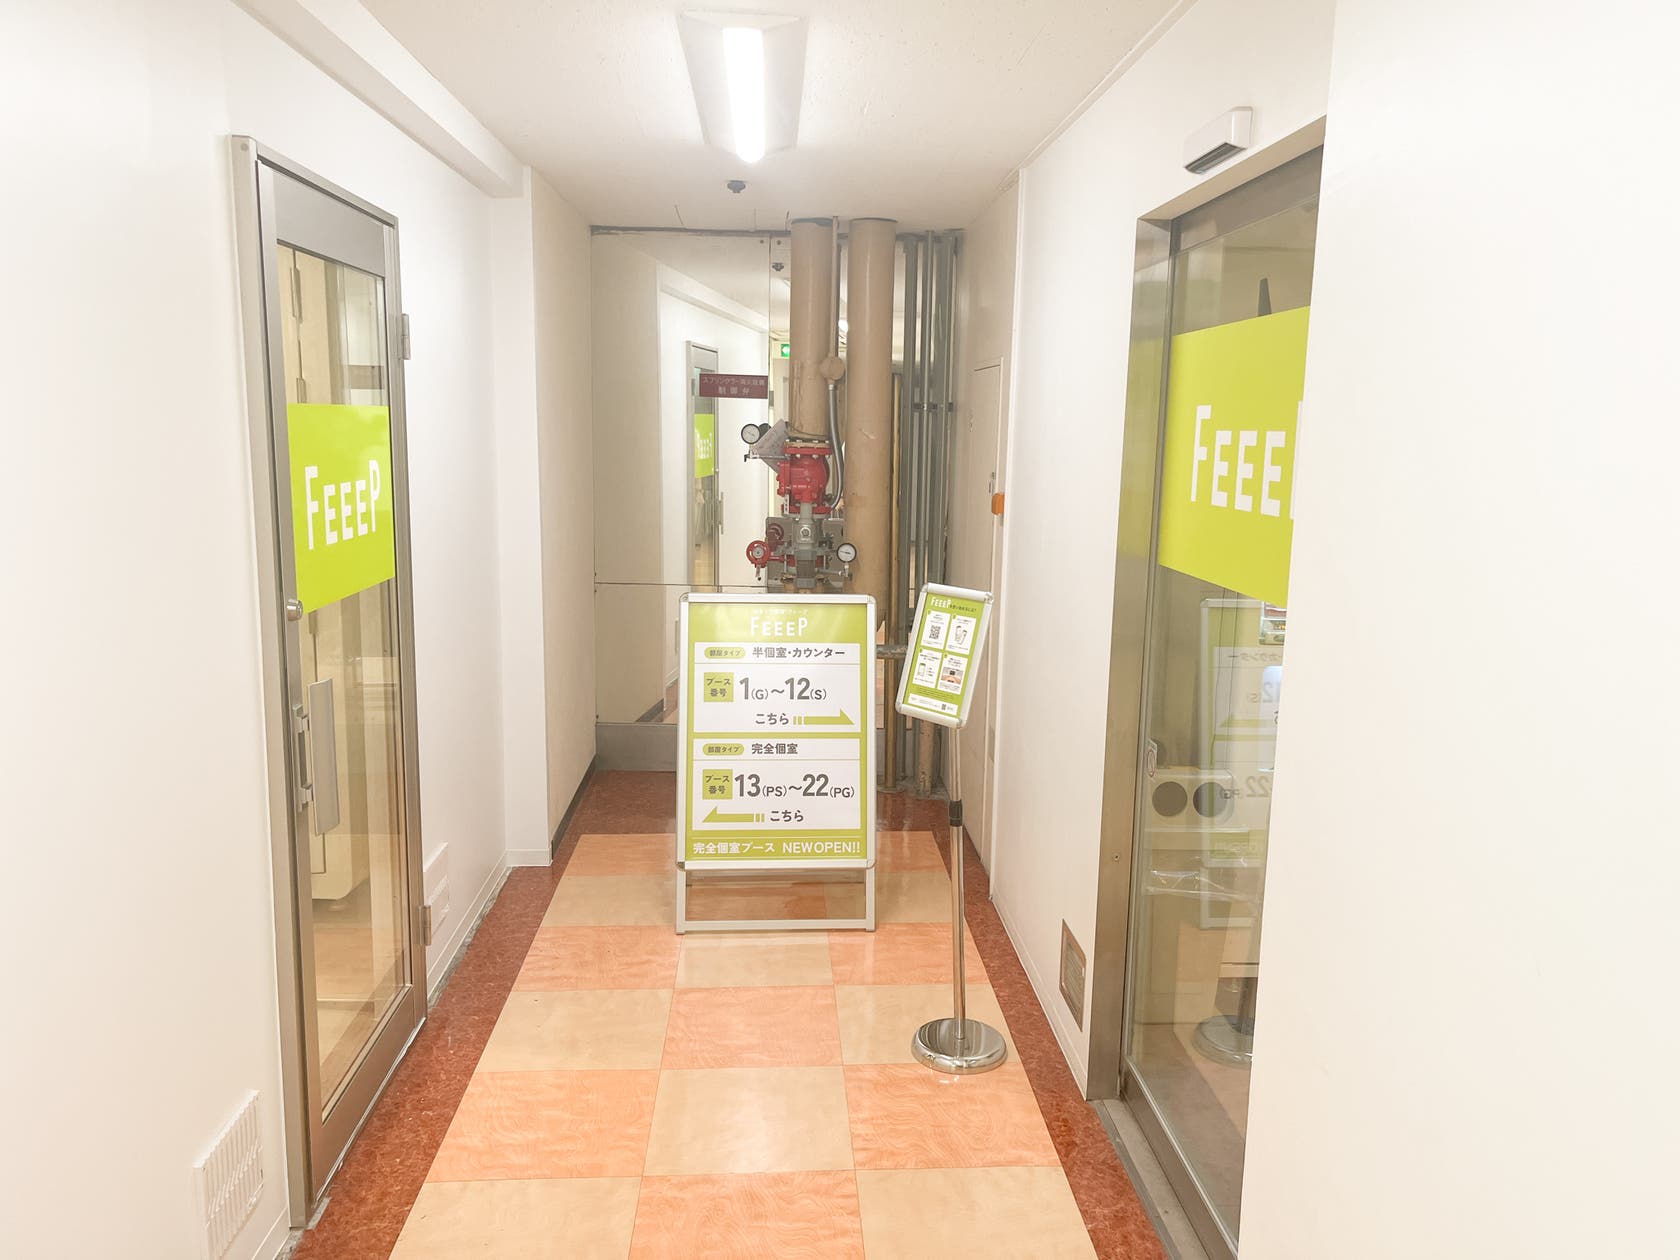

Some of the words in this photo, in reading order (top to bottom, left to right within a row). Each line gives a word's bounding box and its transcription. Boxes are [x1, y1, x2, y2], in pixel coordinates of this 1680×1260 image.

[1191, 400, 1303, 519] FEEE
[752, 646, 845, 659] 半個室・カウンター
[706, 677, 731, 686] ブース
[710, 688, 727, 697] 番号
[755, 713, 789, 725] こちら
[751, 743, 798, 755] 完全個室
[705, 774, 730, 783] ブース
[708, 785, 726, 795] 番号
[770, 809, 804, 823] こちら
[693, 842, 775, 855] 完全個室ブース
